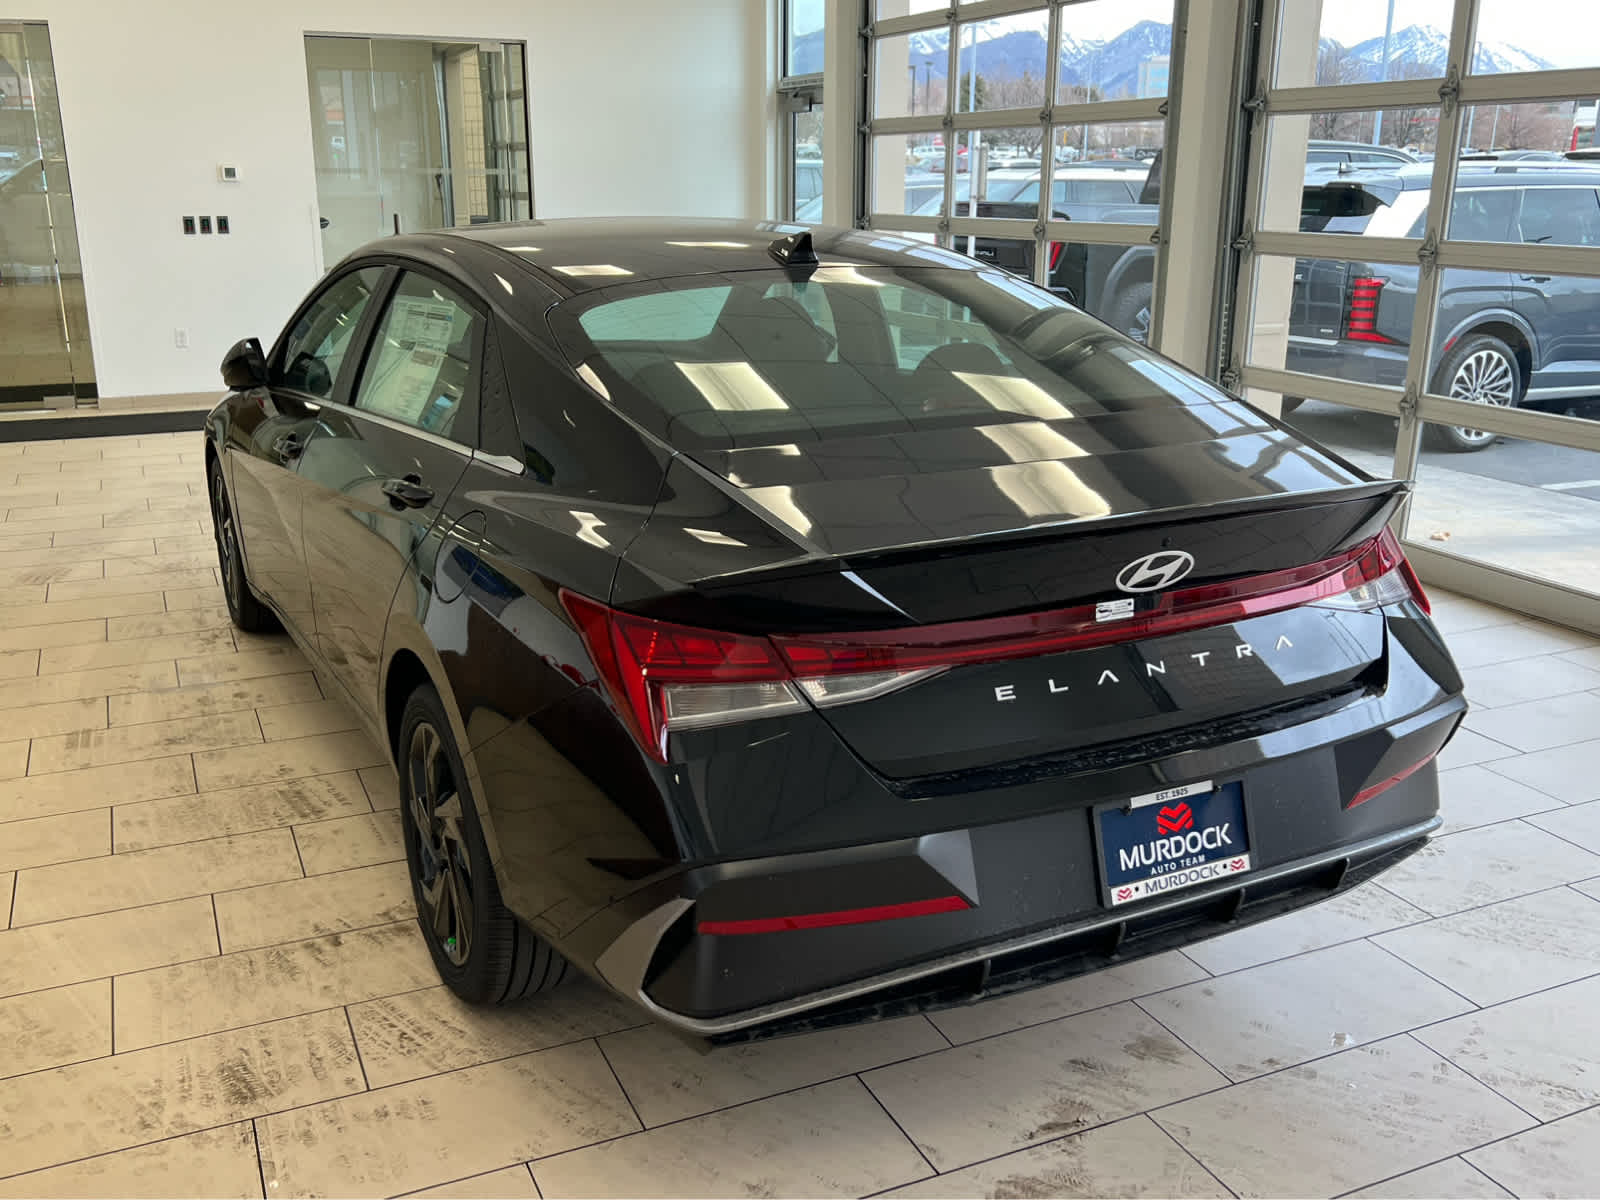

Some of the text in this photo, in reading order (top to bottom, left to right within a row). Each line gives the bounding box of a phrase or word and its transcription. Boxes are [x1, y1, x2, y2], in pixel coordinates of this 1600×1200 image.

[994, 635, 1293, 701] ELANTRA
[1172, 787, 1188, 798] 1925
[1119, 823, 1232, 871] MURDOCK
[1145, 864, 1219, 894] MURDOCK
[1151, 855, 1205, 875] AUTO TEAM
